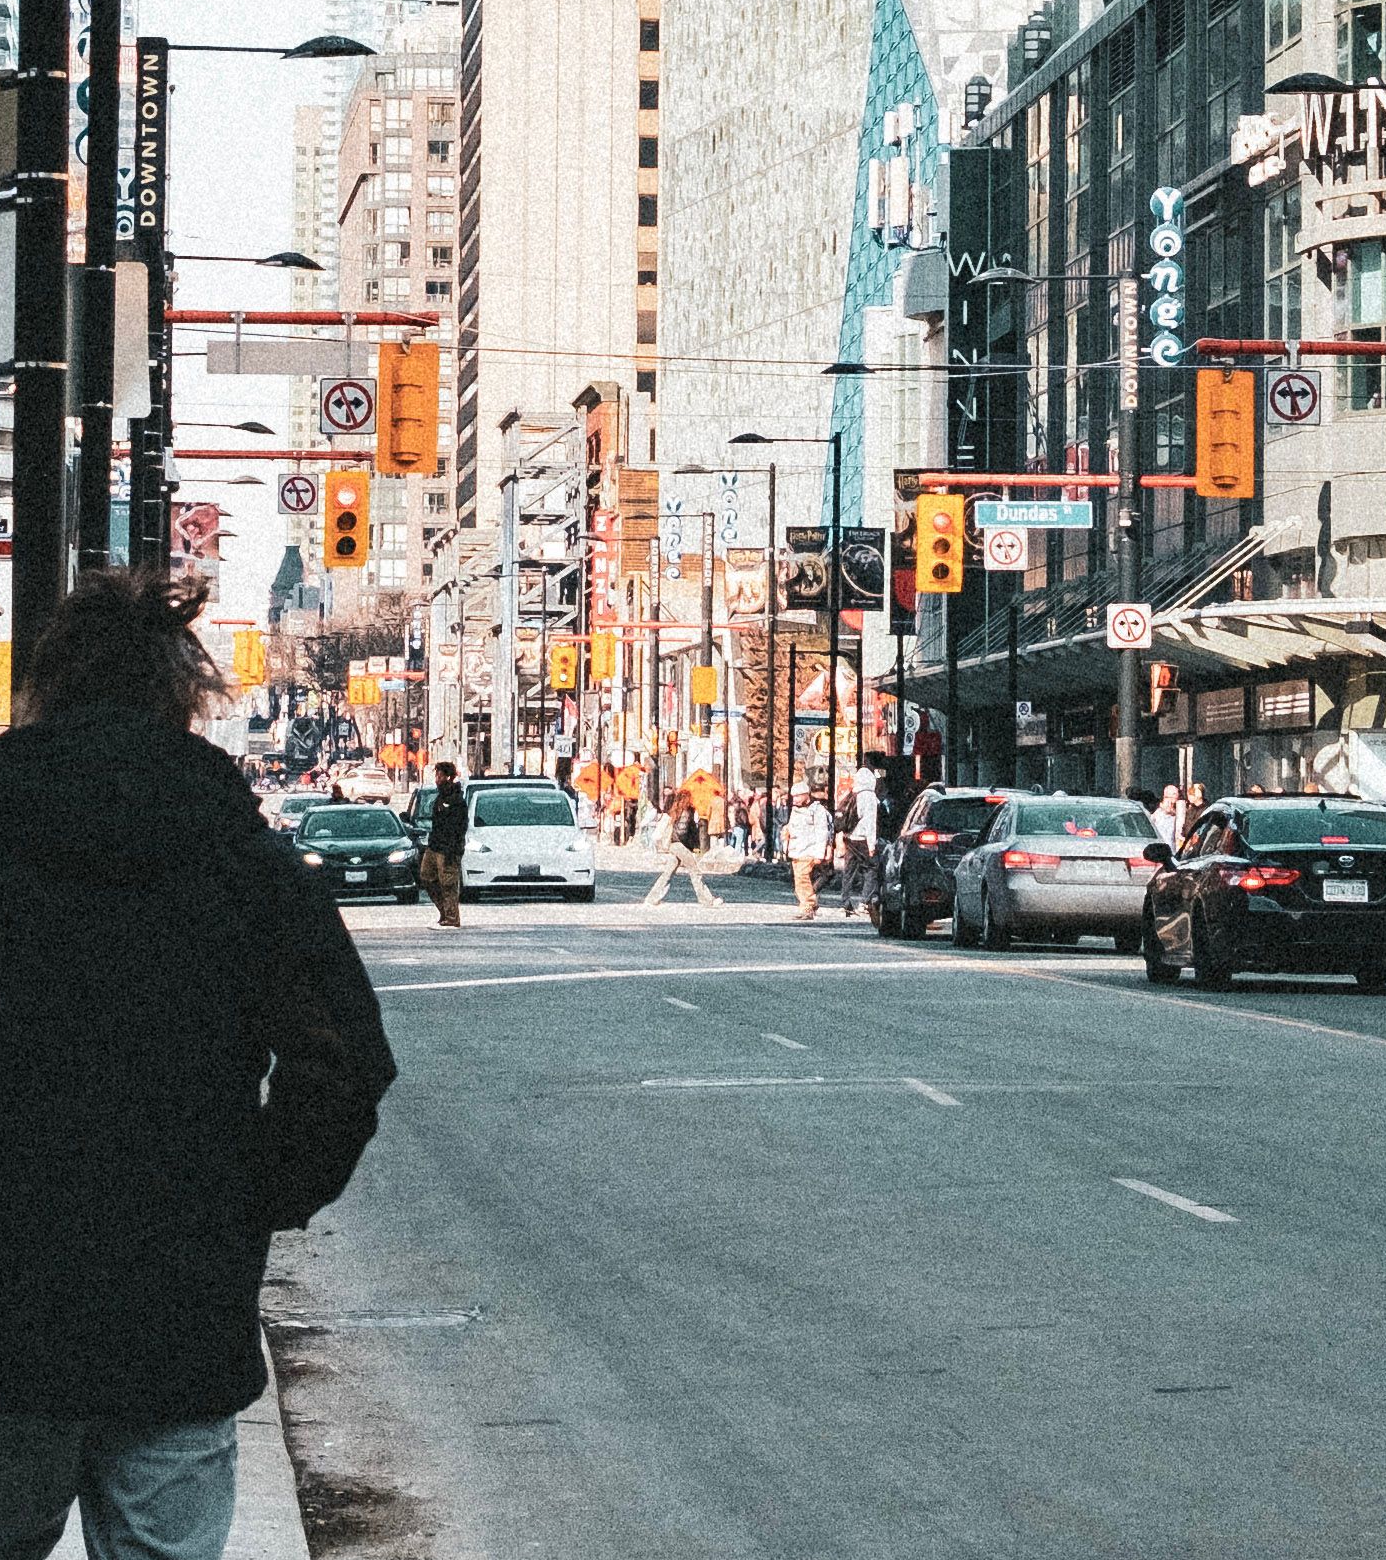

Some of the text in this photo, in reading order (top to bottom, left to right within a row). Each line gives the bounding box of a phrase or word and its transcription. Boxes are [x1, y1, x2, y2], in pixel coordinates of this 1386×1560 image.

[140, 53, 160, 228] DOWNTOWN
[1124, 281, 1138, 408] DOWNTOWN
[1149, 187, 1185, 366] Yonge
[996, 504, 1058, 522] Dundas
